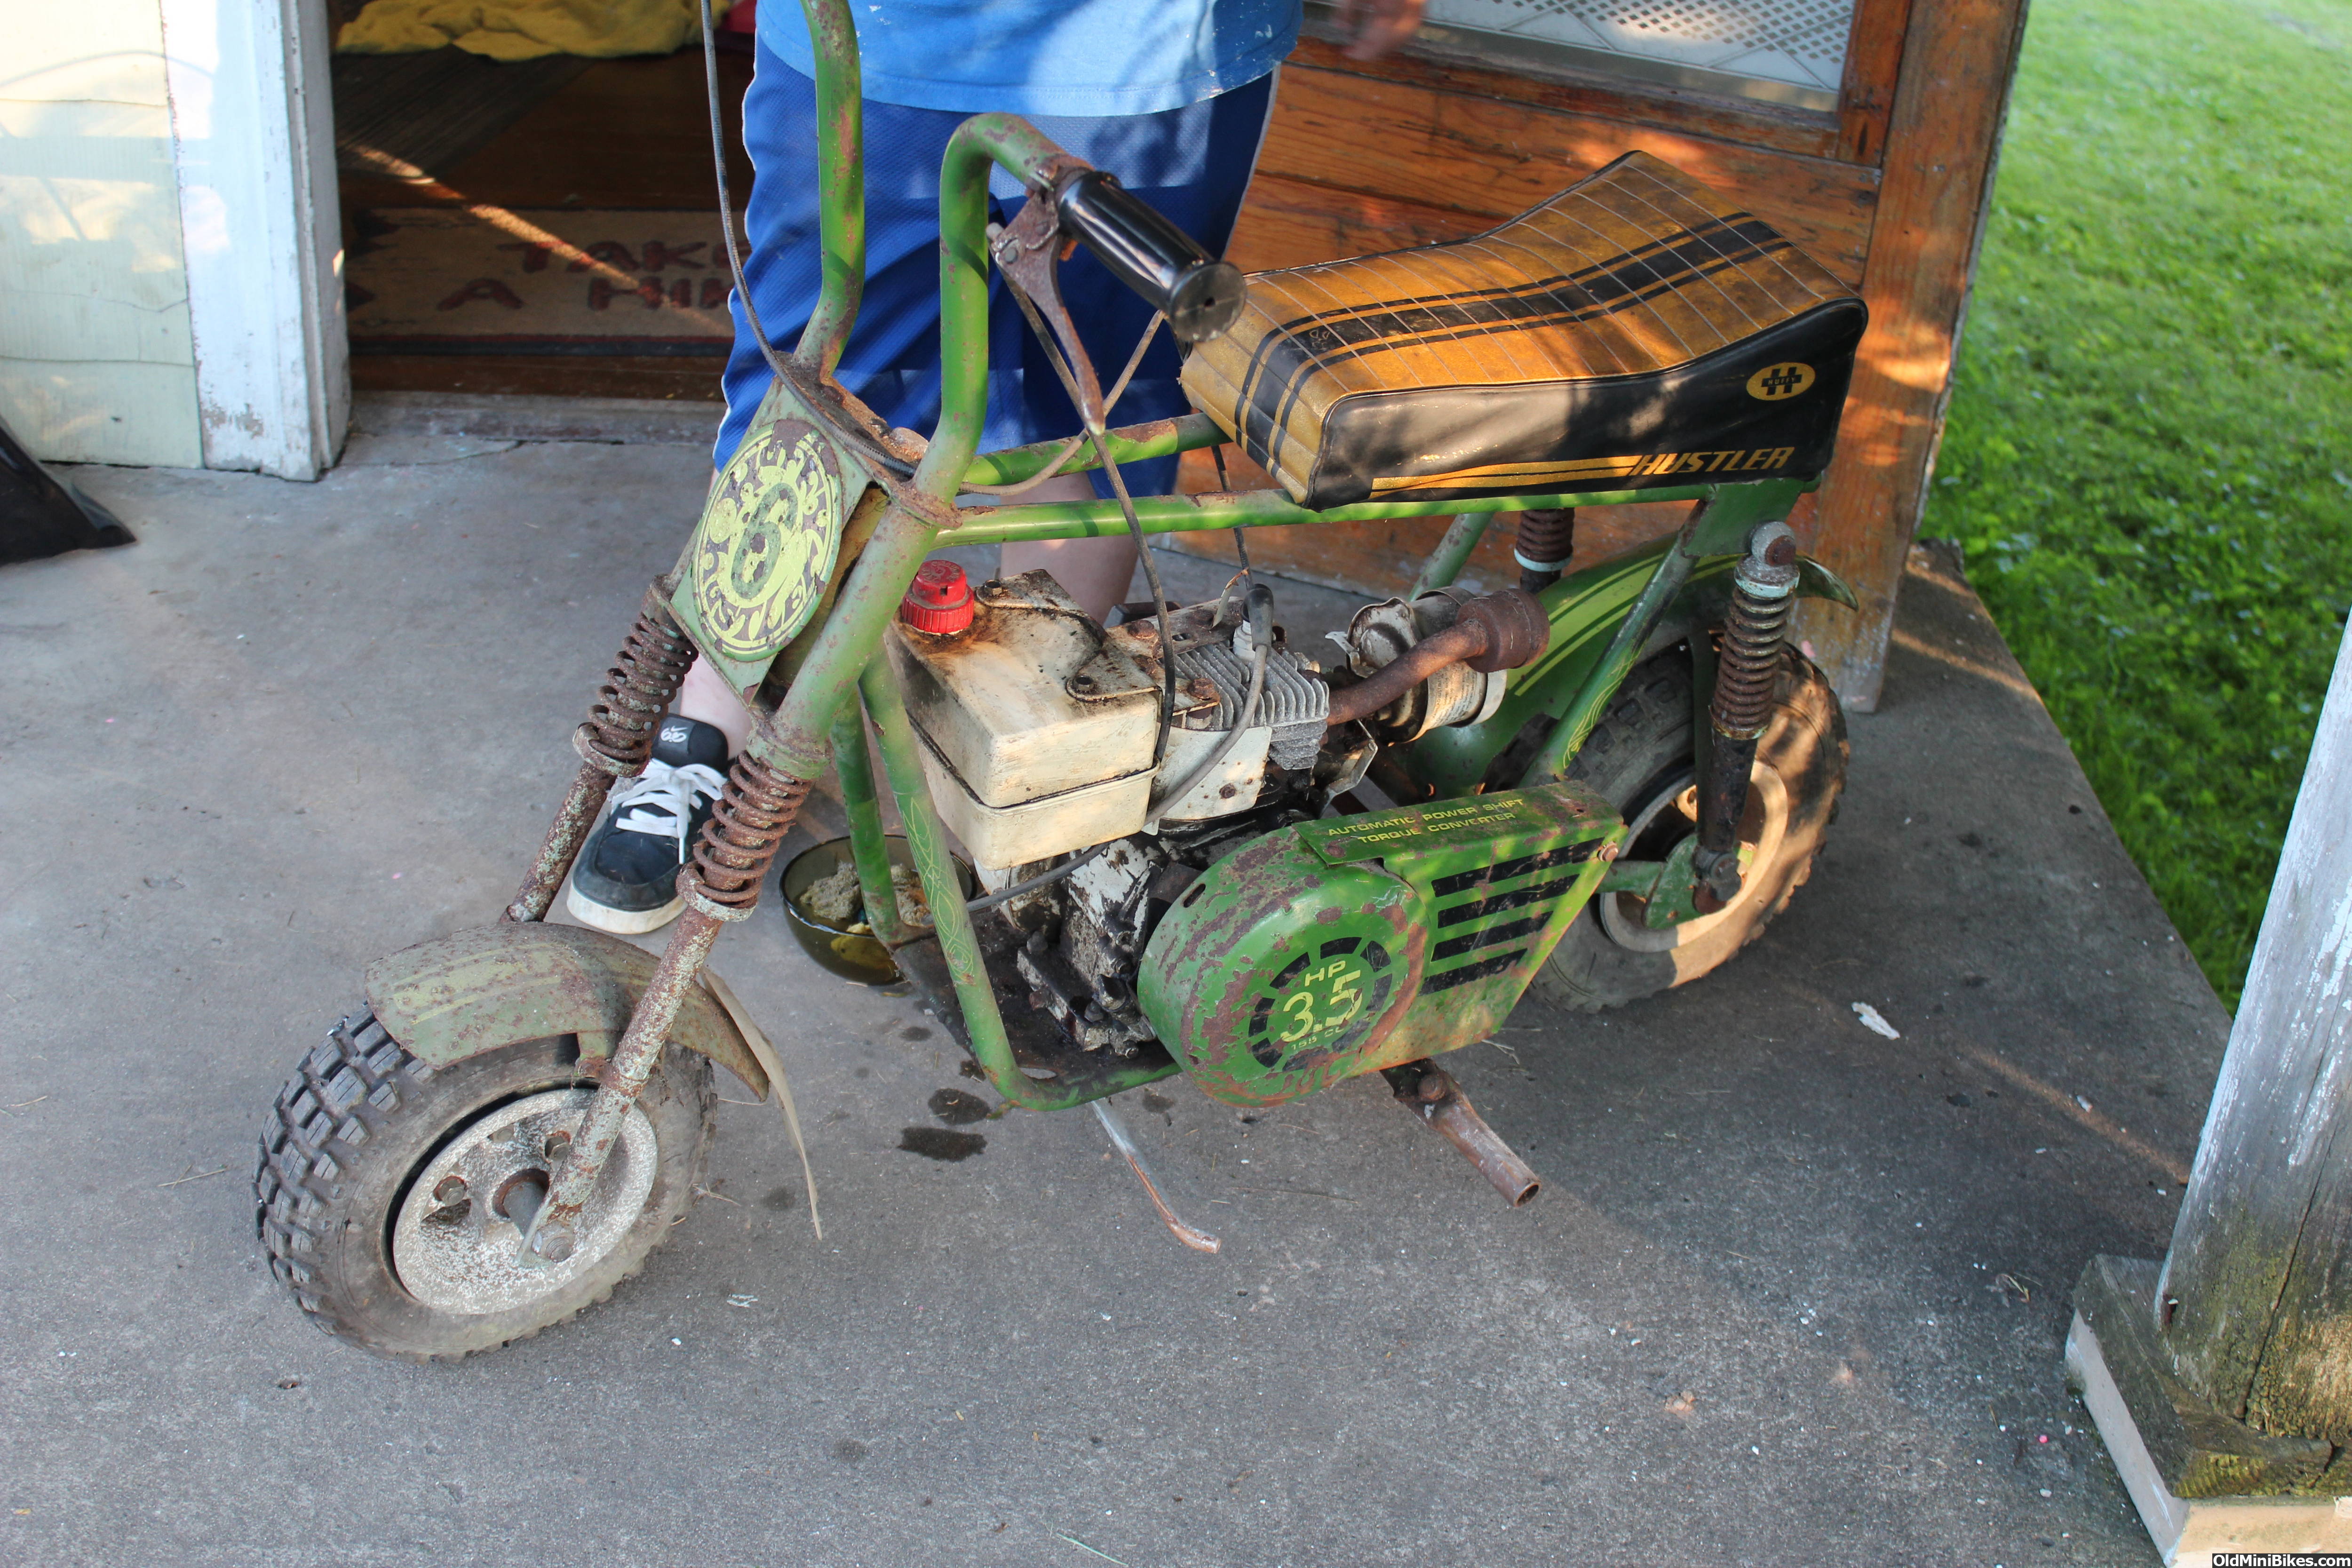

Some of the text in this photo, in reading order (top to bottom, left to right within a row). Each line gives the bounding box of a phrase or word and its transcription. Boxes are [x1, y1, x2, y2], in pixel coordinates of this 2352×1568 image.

[437, 277, 525, 311] A
[1629, 446, 1795, 476] HUSTLER
[1328, 799, 1525, 836] AUTOMATIC POWER SHIFT
[1357, 812, 1516, 844] TORQUE CONVERTER
[1304, 960, 1346, 987] HP
[1280, 969, 1362, 1043] 3.5
